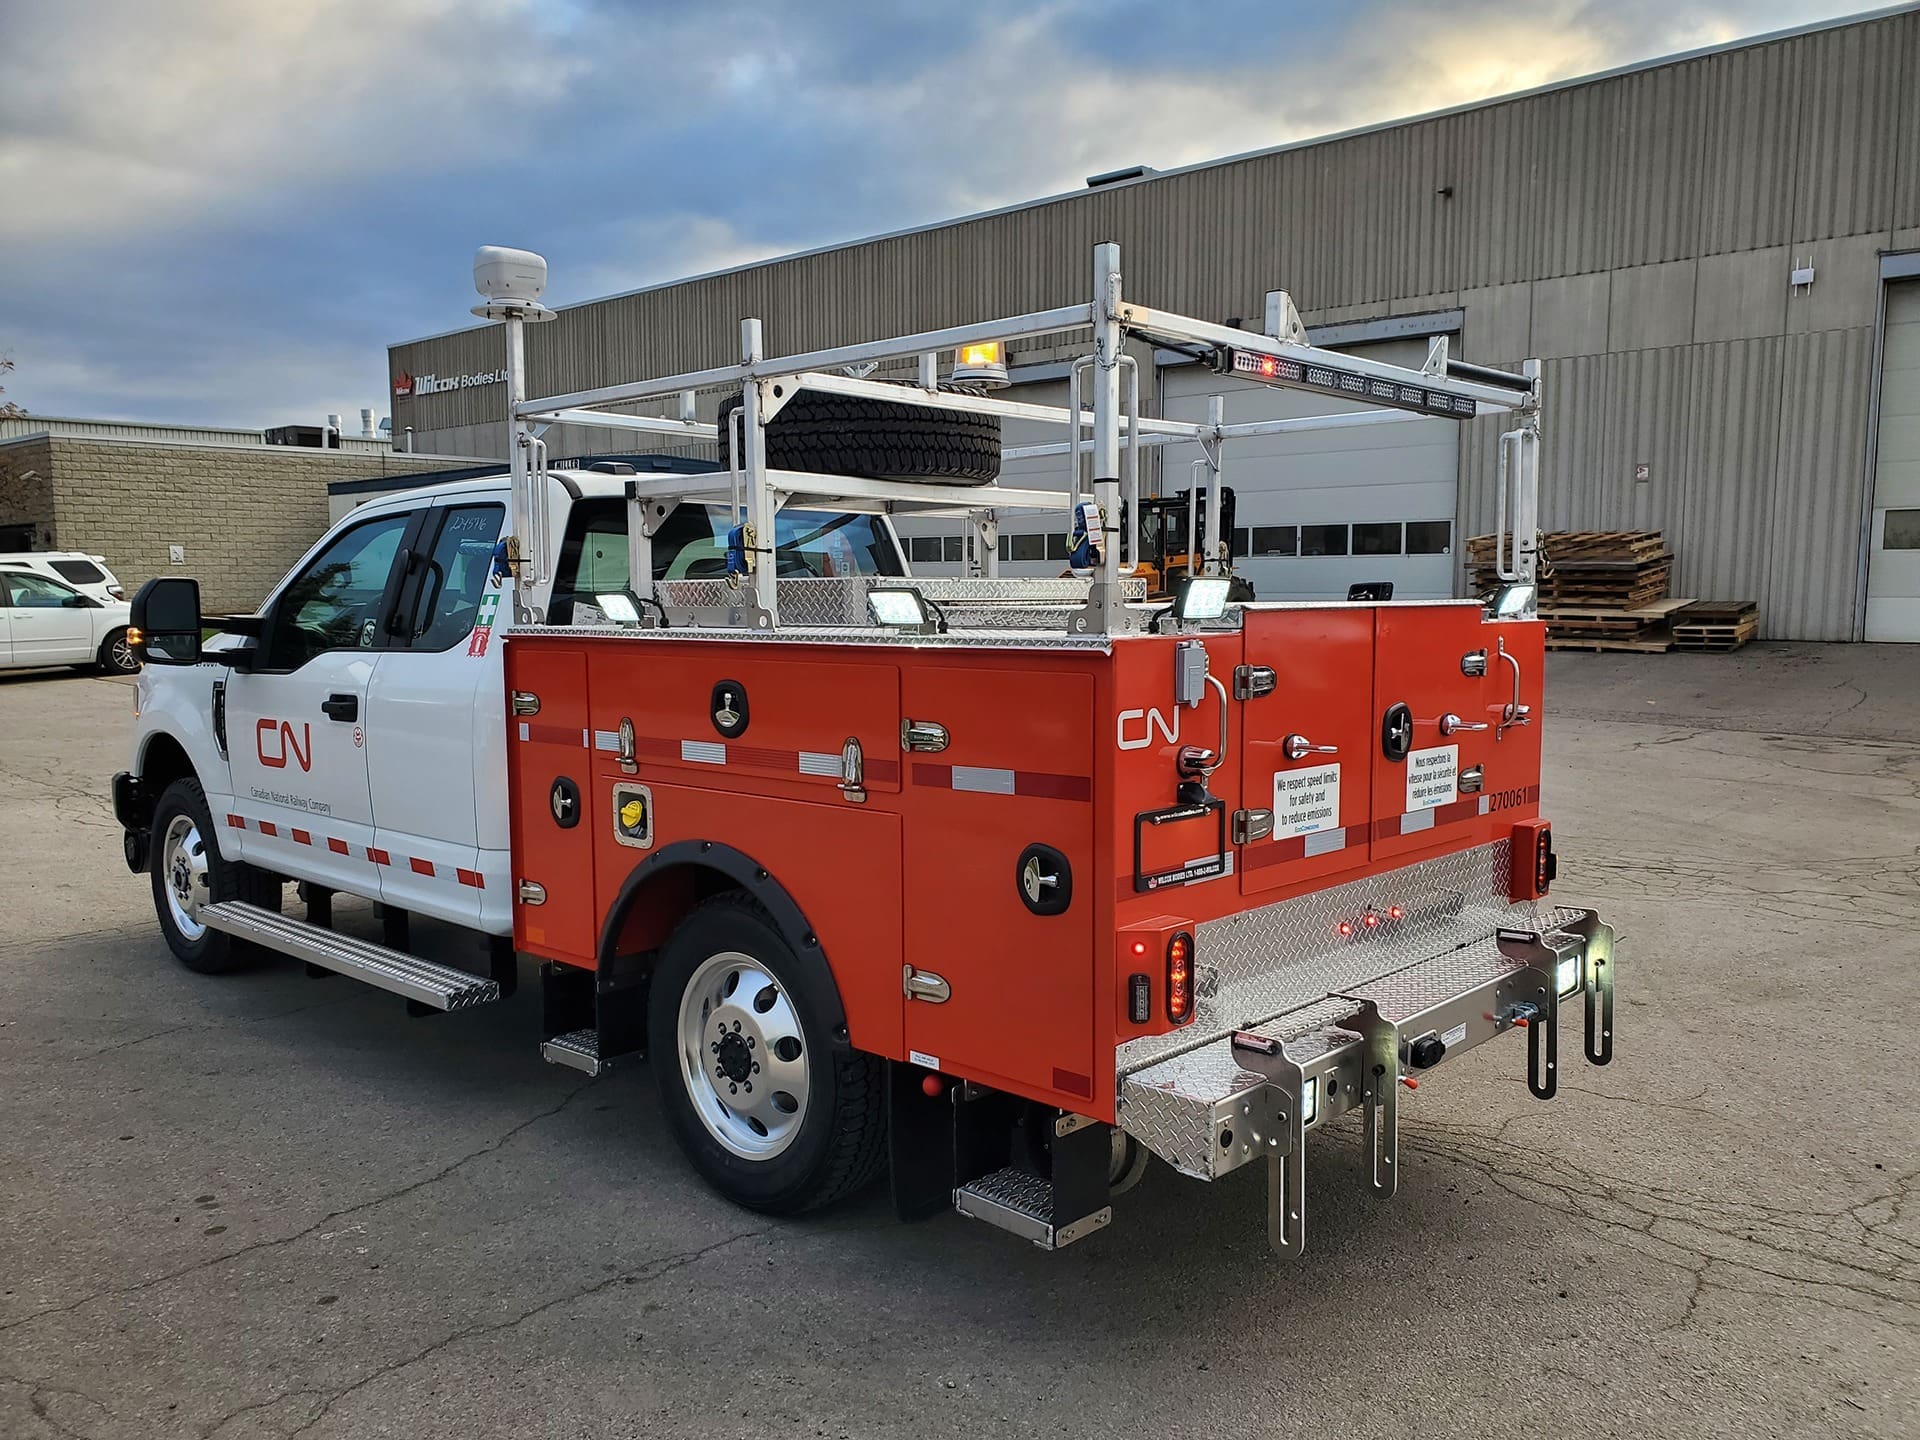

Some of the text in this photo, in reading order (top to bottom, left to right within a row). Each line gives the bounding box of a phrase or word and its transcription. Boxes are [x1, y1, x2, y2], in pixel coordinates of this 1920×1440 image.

[415, 373, 460, 396] Wilcox
[461, 371, 494, 388] Bodies
[1117, 705, 1180, 751] CN
[256, 718, 312, 772] CN
[1277, 771, 1338, 792] We respect speed limits
[270, 790, 289, 805] National
[290, 794, 308, 811] Railway
[308, 798, 331, 816] Company
[1289, 789, 1326, 807] for safety and
[1490, 787, 1527, 812] 270061
[1281, 806, 1332, 826] to reduce emissions
